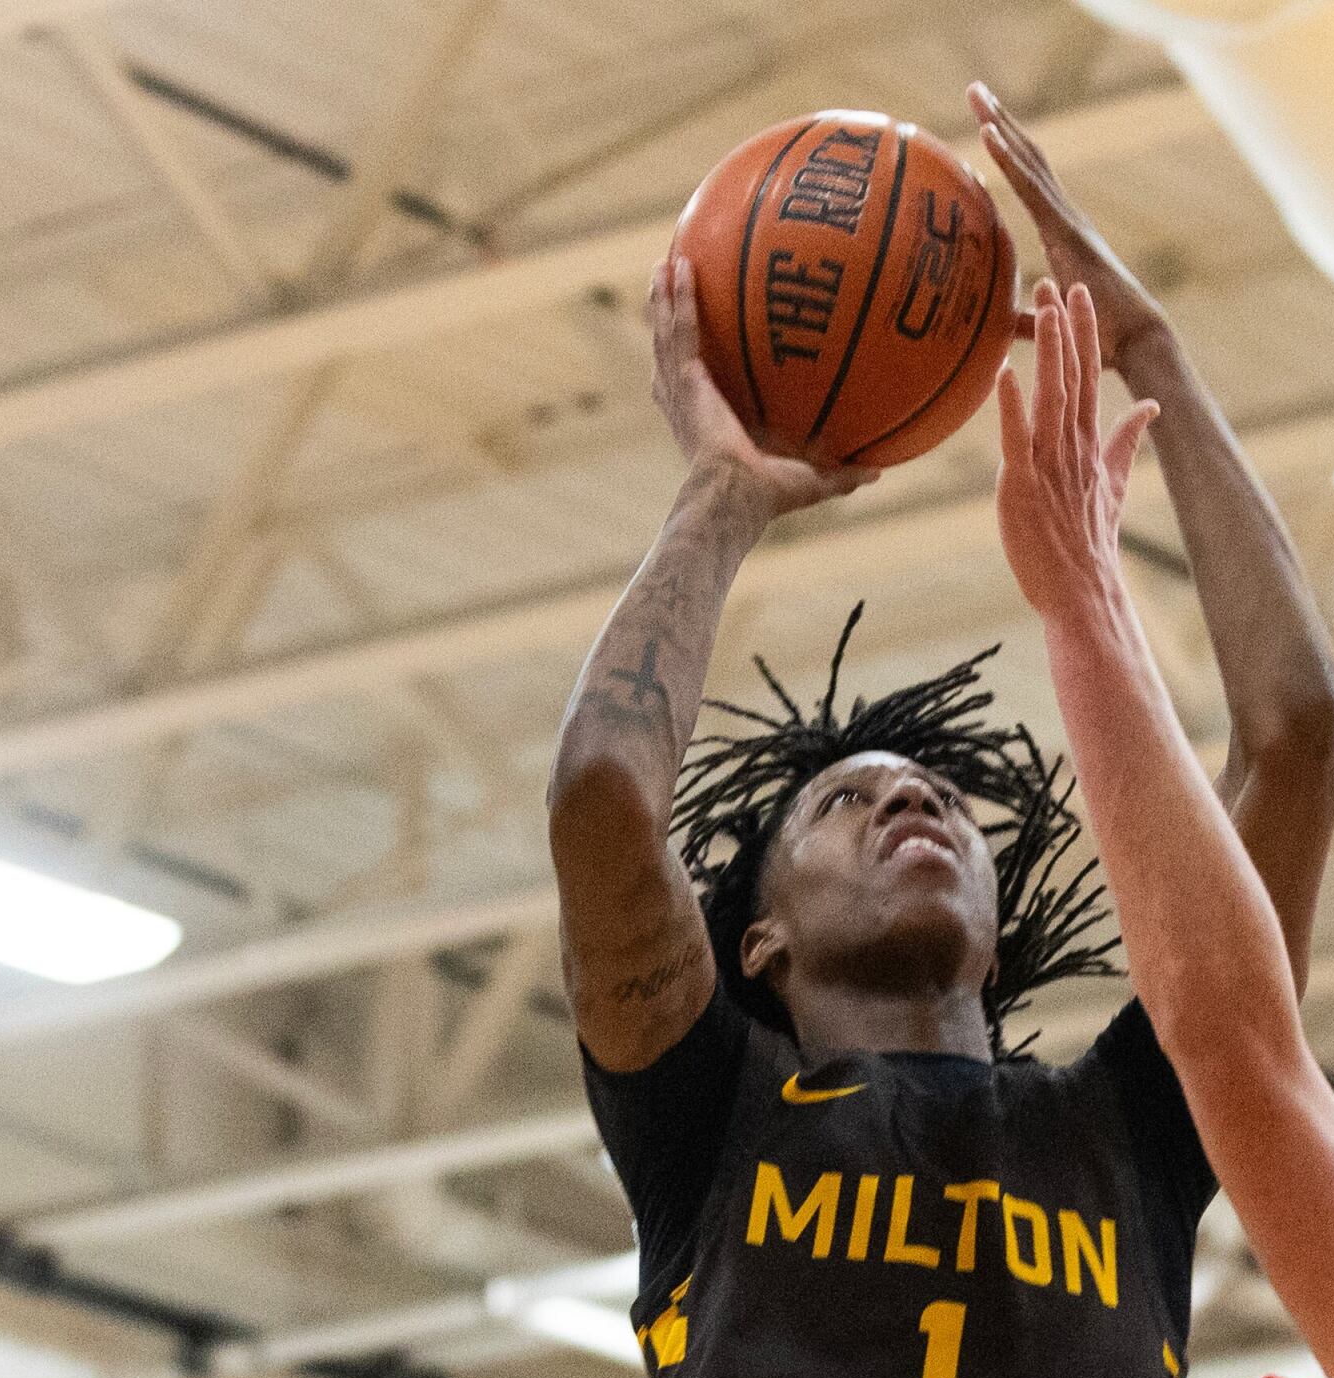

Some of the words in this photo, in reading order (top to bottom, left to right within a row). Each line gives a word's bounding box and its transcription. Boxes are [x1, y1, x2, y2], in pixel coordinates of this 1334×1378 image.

[779, 127, 884, 236] ROCK
[765, 248, 846, 368] THE
[745, 1160, 1119, 1309] MILTON
